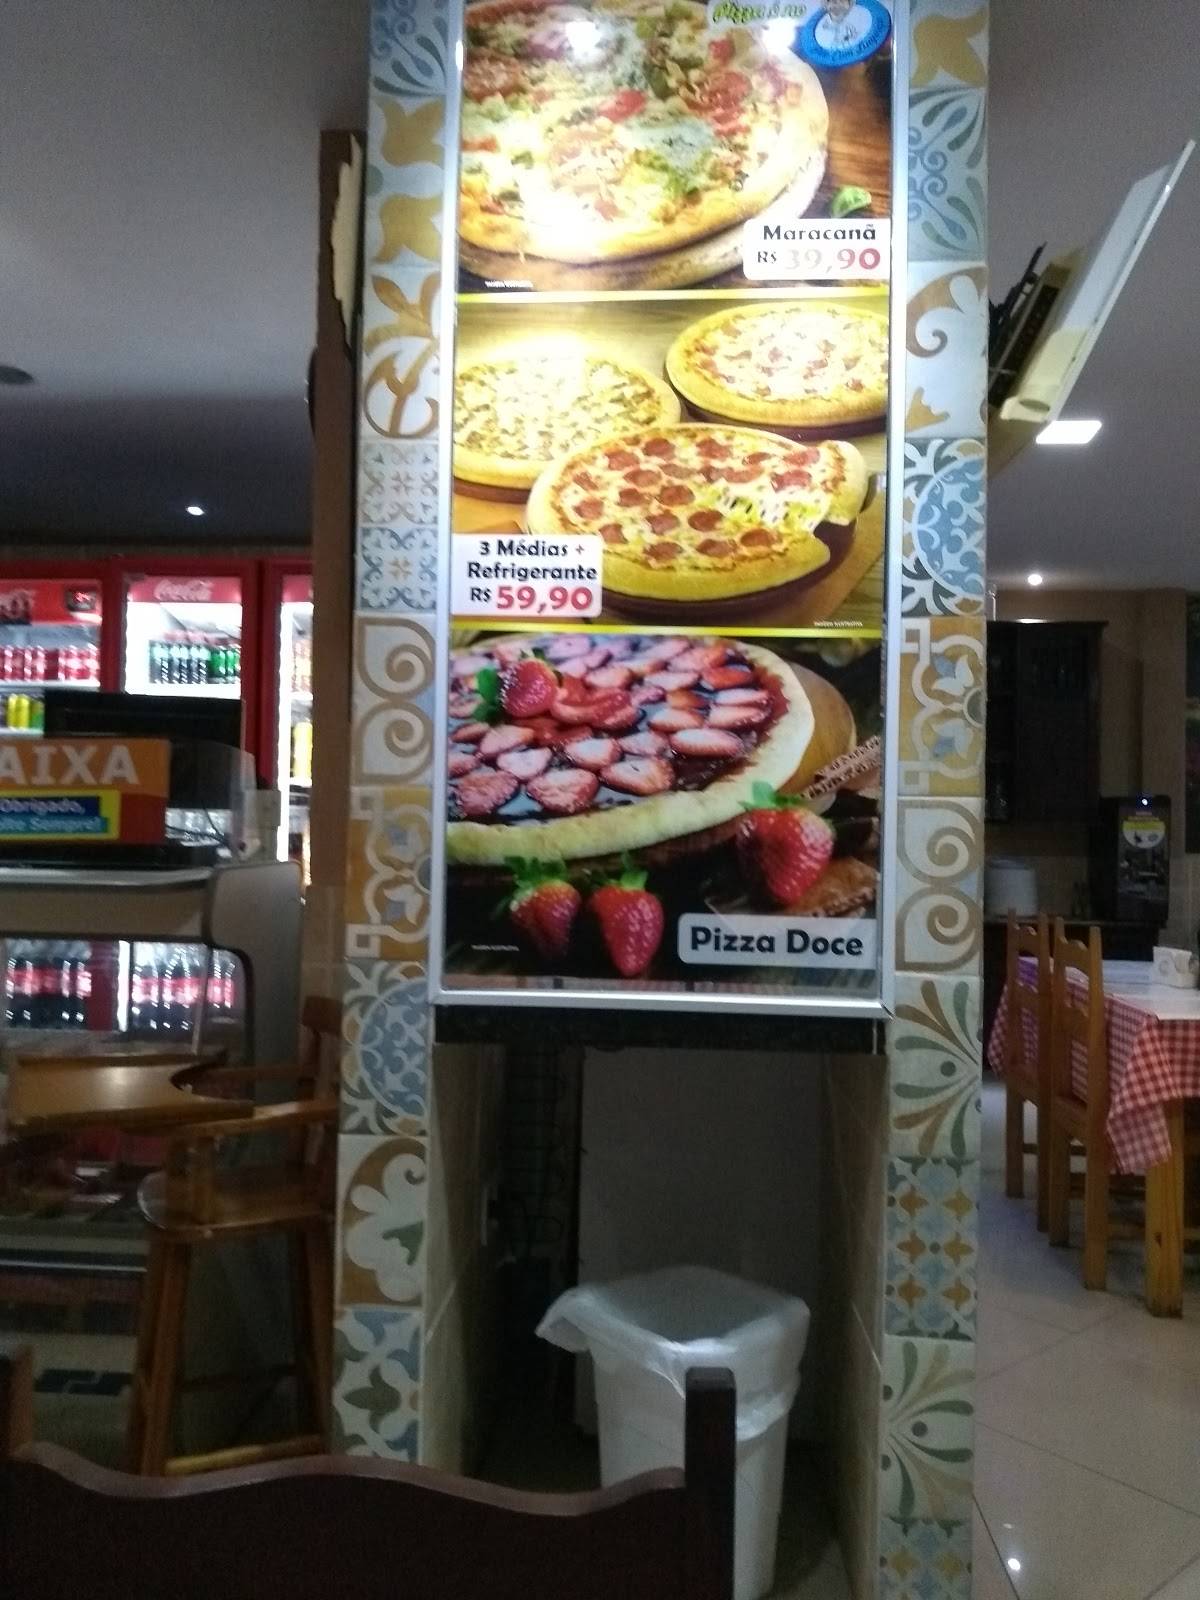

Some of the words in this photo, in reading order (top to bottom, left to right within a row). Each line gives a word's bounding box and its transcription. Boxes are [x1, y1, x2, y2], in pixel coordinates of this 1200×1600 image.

[763, 224, 876, 241] Maracanã
[785, 248, 881, 273] 39,90
[479, 541, 490, 556] 3
[497, 539, 568, 556] Médias
[467, 561, 597, 581] Refrigerante
[470, 586, 492, 602] R$
[496, 585, 593, 613] 59,90
[690, 926, 776, 953] Pizza
[786, 928, 863, 956] Doce
